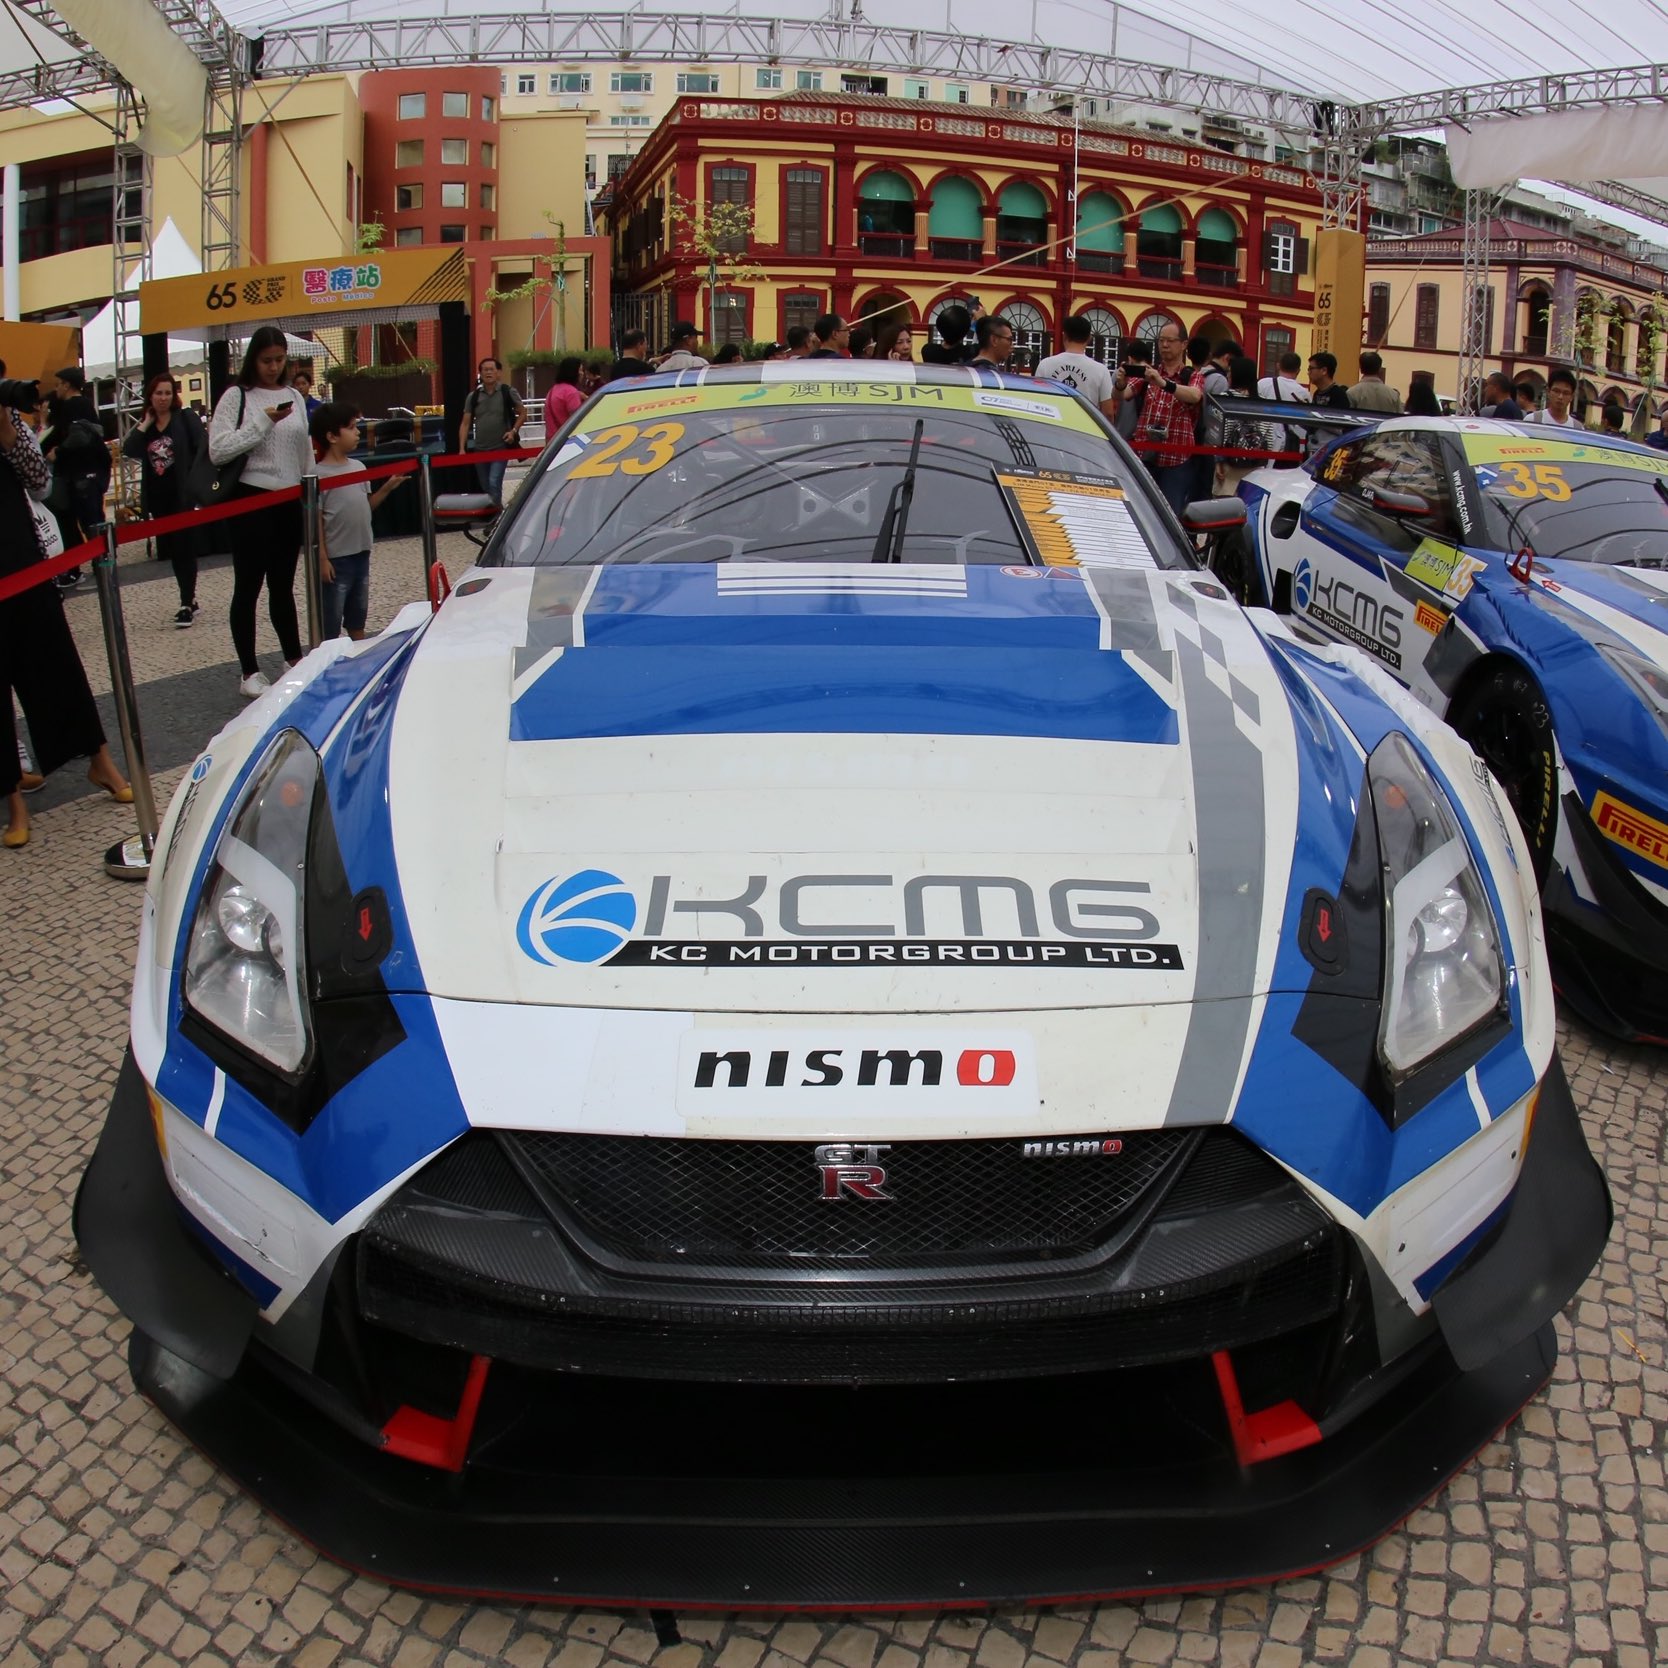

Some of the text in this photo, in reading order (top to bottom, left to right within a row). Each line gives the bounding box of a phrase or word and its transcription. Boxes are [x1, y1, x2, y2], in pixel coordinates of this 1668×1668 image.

[206, 282, 237, 310] 65
[304, 265, 380, 294] 醫療站
[1318, 292, 1331, 309] 65
[789, 383, 943, 401] 澳博 SJM
[566, 422, 685, 479] 23
[1324, 448, 1349, 480] 35
[1499, 461, 1573, 502] 35
[1447, 558, 1485, 596] 35
[1313, 569, 1404, 649] KCMG
[1312, 606, 1400, 666] KC MOTORGROUP LTD.
[1536, 750, 1552, 849] PIRELLI
[1597, 802, 1668, 862] PIREL
[644, 875, 1160, 941] KCMG
[650, 945, 1170, 964] KC MOTORGROUP LTD.
[694, 1050, 1016, 1087] nismo
[814, 1144, 891, 1164] GT
[1023, 1139, 1122, 1158] nismo
[818, 1164, 895, 1200] R
